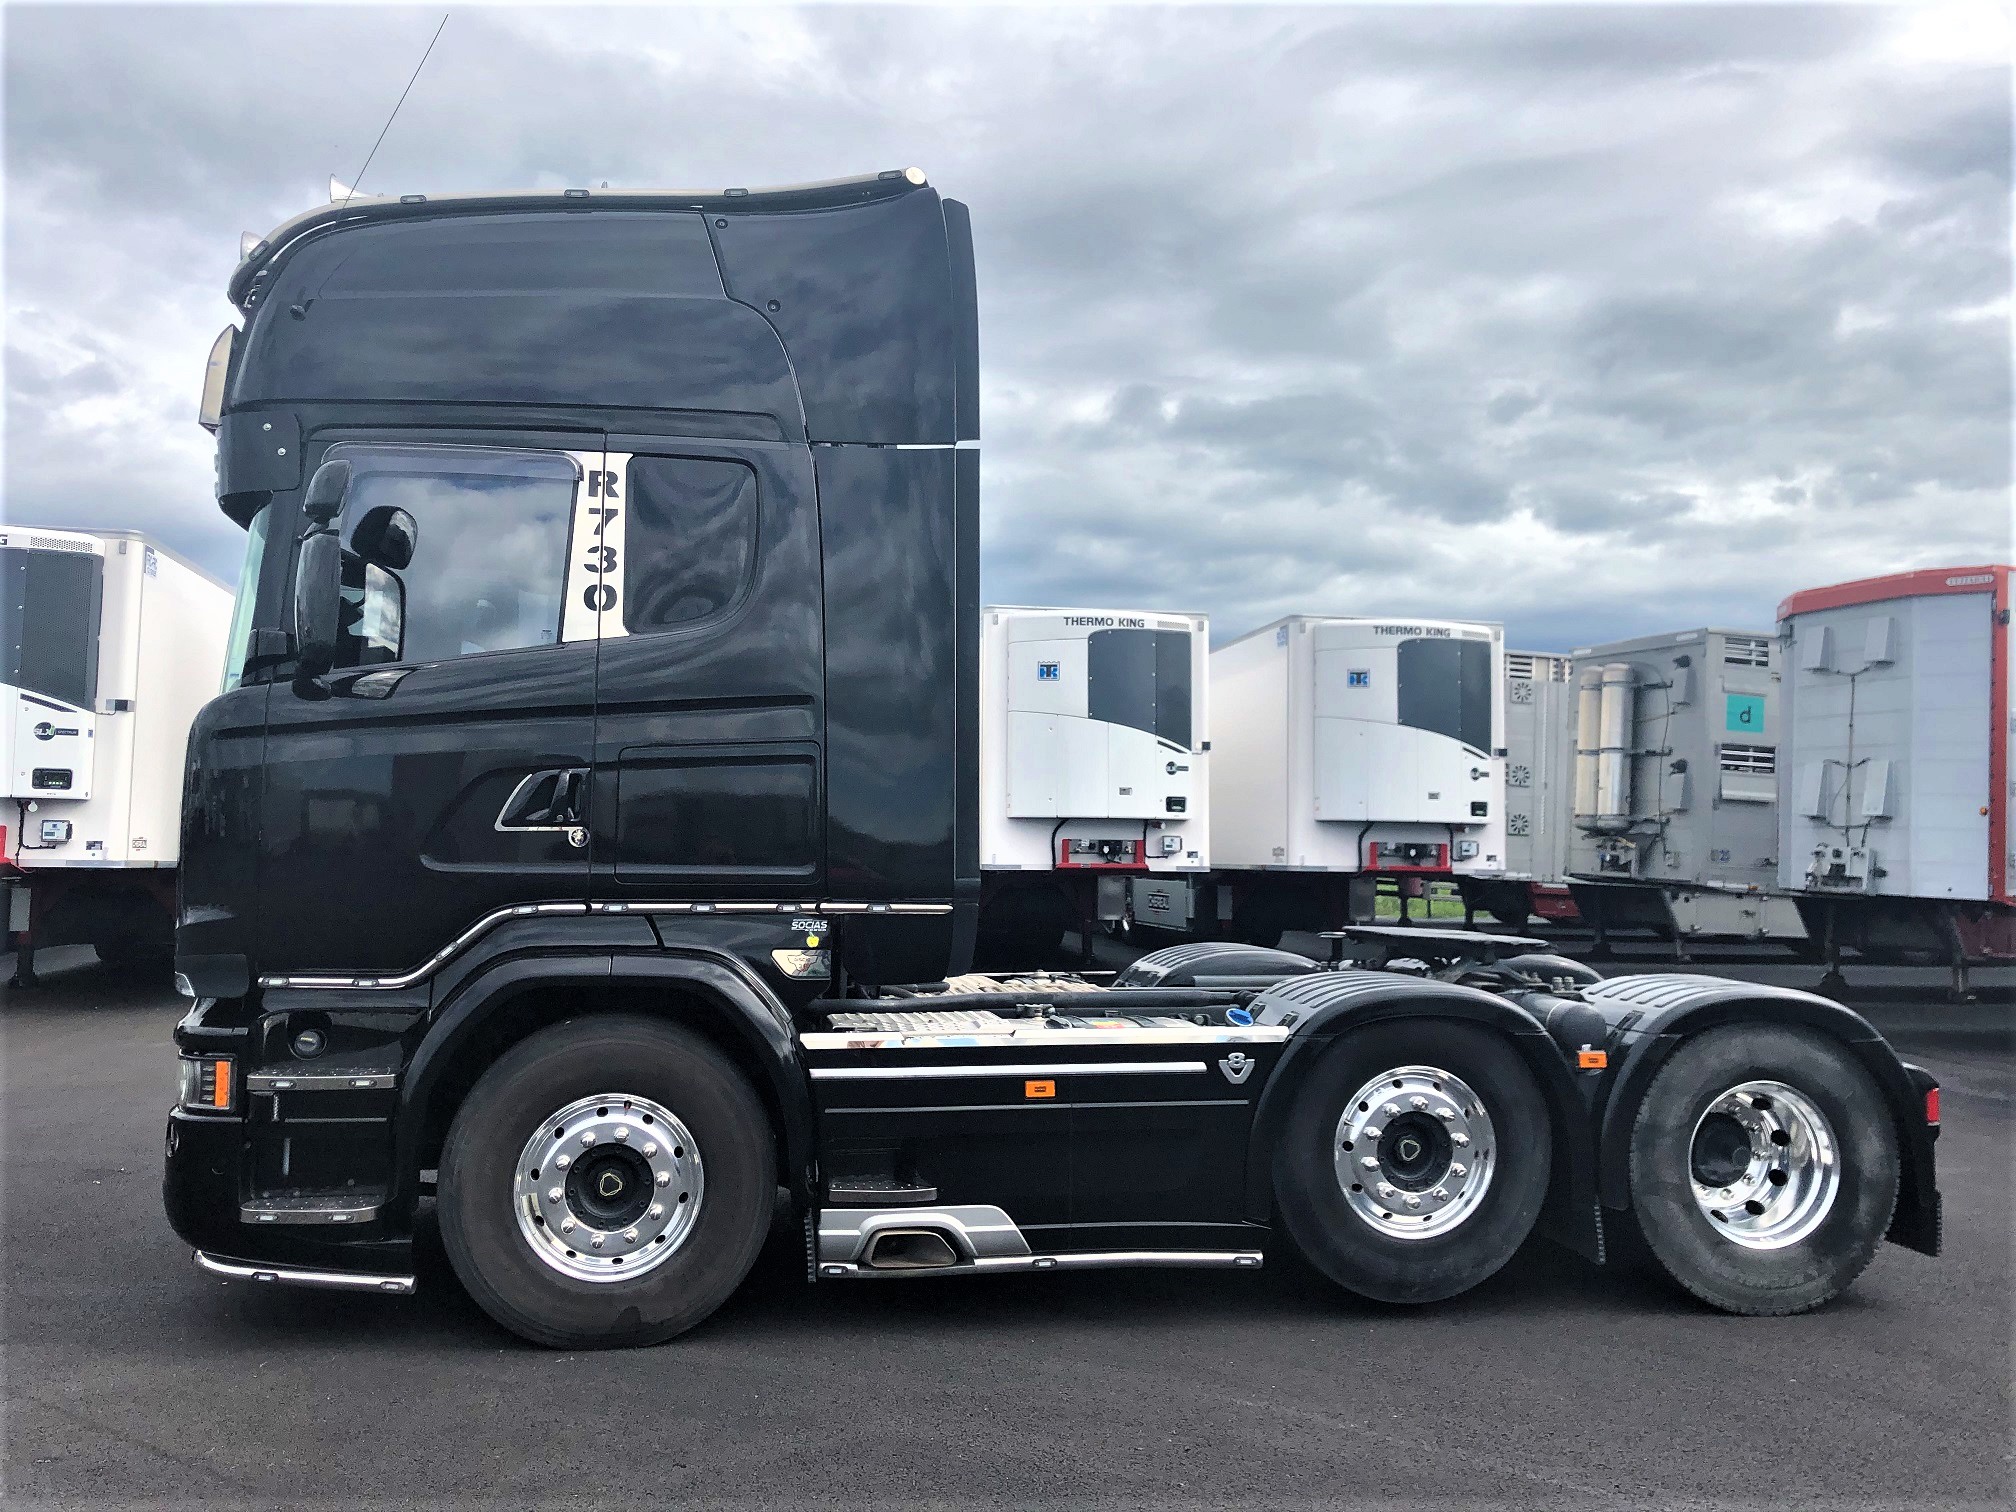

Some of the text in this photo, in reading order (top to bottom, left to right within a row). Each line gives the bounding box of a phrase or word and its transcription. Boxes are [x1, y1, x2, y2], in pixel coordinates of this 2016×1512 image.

[1063, 616, 1145, 628] THERMO KING
[1372, 625, 1451, 638] THERMO KING
[791, 921, 828, 929] SOCIAS
